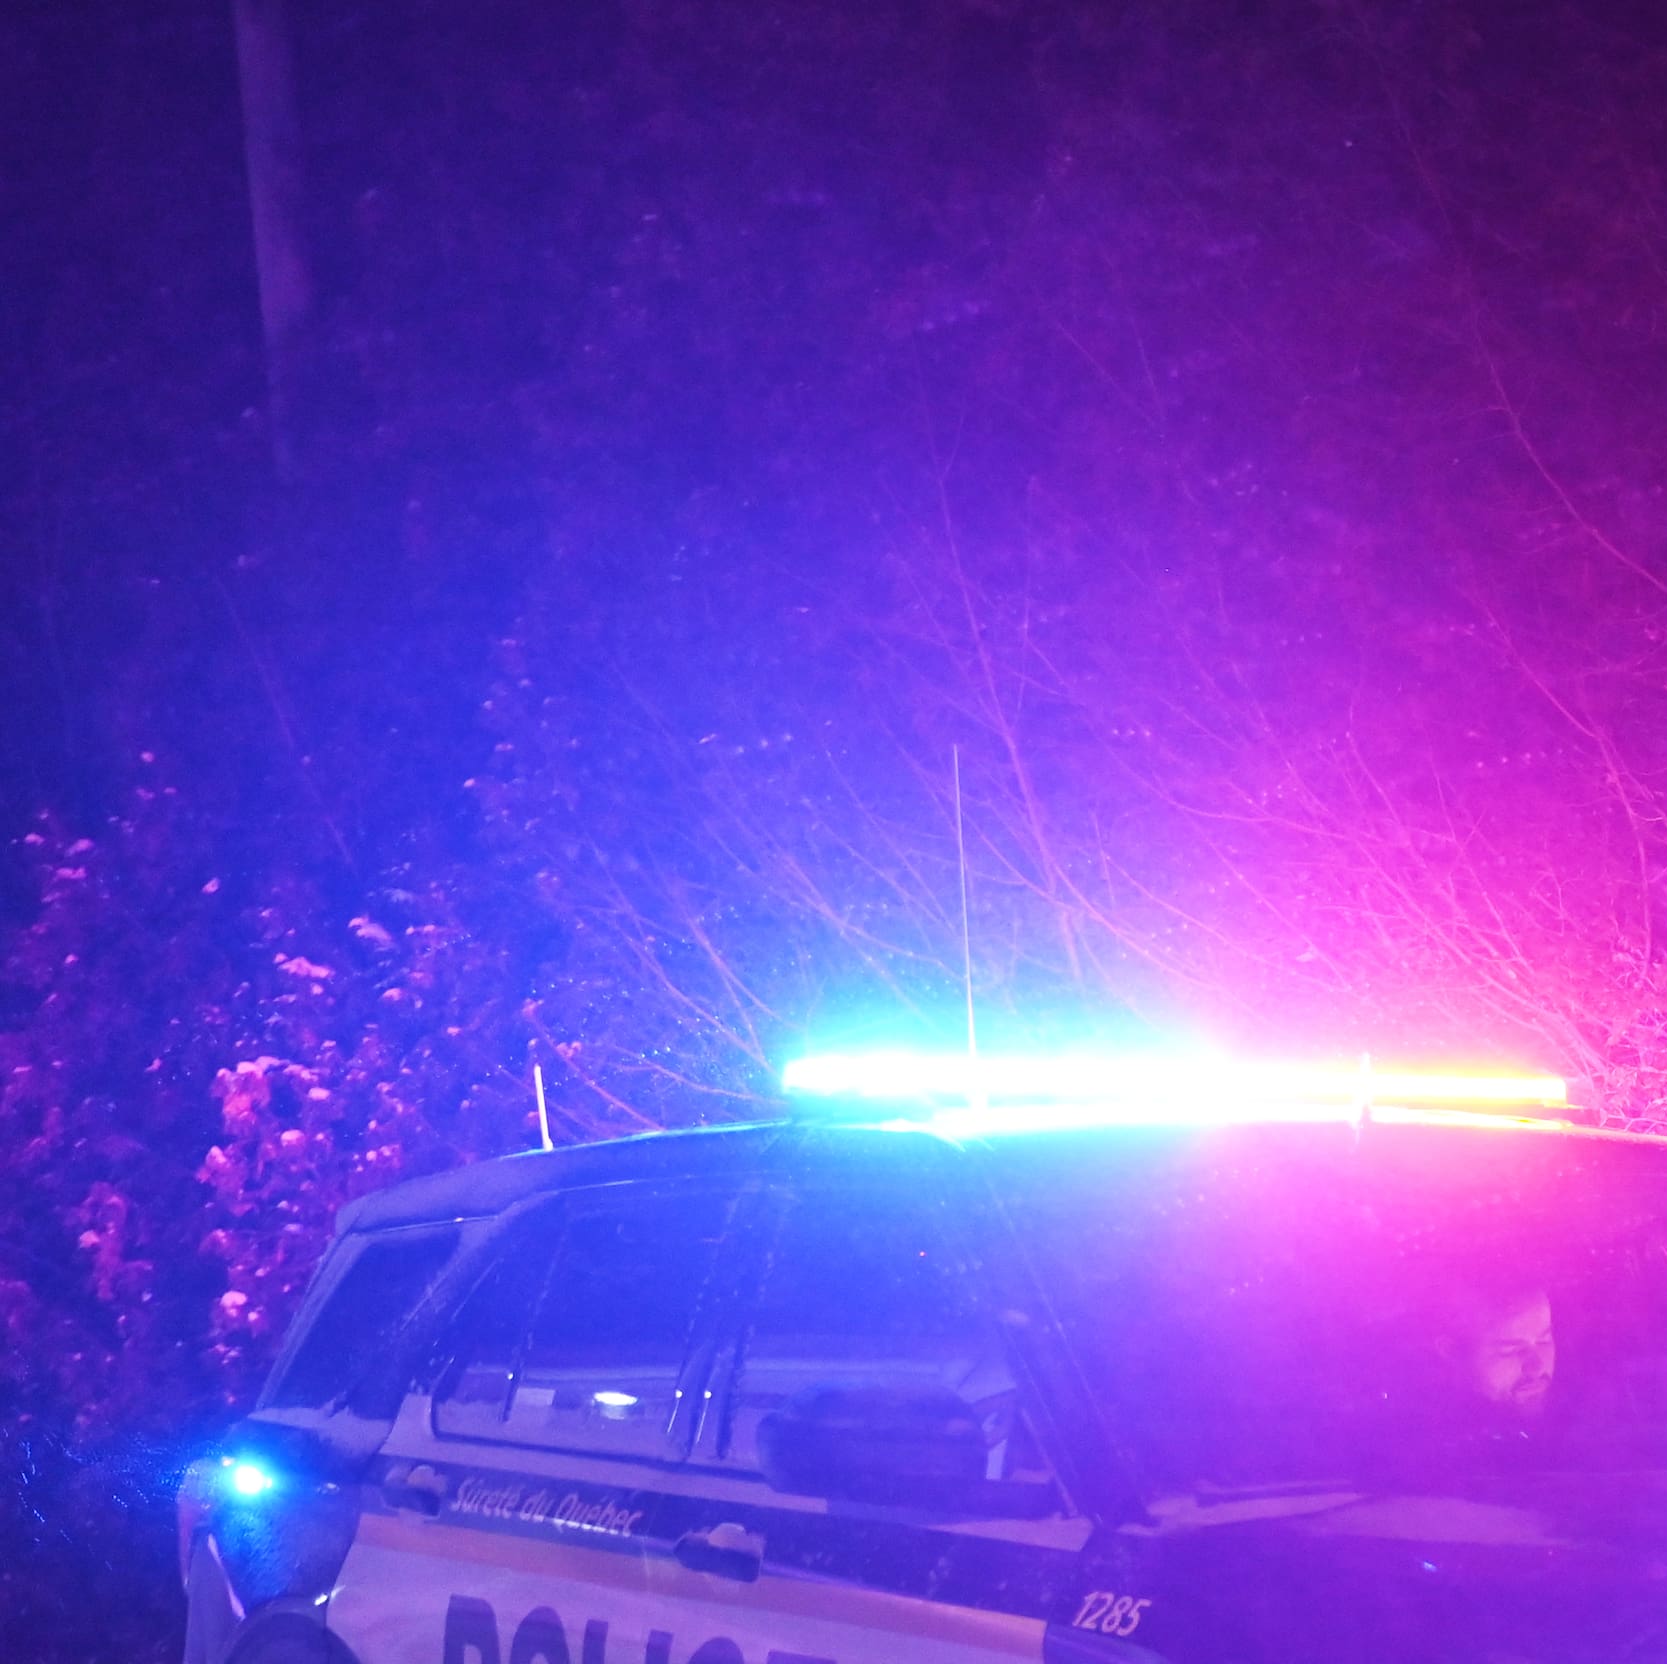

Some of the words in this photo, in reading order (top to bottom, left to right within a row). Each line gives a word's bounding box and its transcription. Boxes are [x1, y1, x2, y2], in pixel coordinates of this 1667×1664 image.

[451, 1477, 525, 1519] Sûreté
[520, 1488, 551, 1522] du
[552, 1492, 643, 1537] Québec
[1072, 1591, 1152, 1636] 1285
